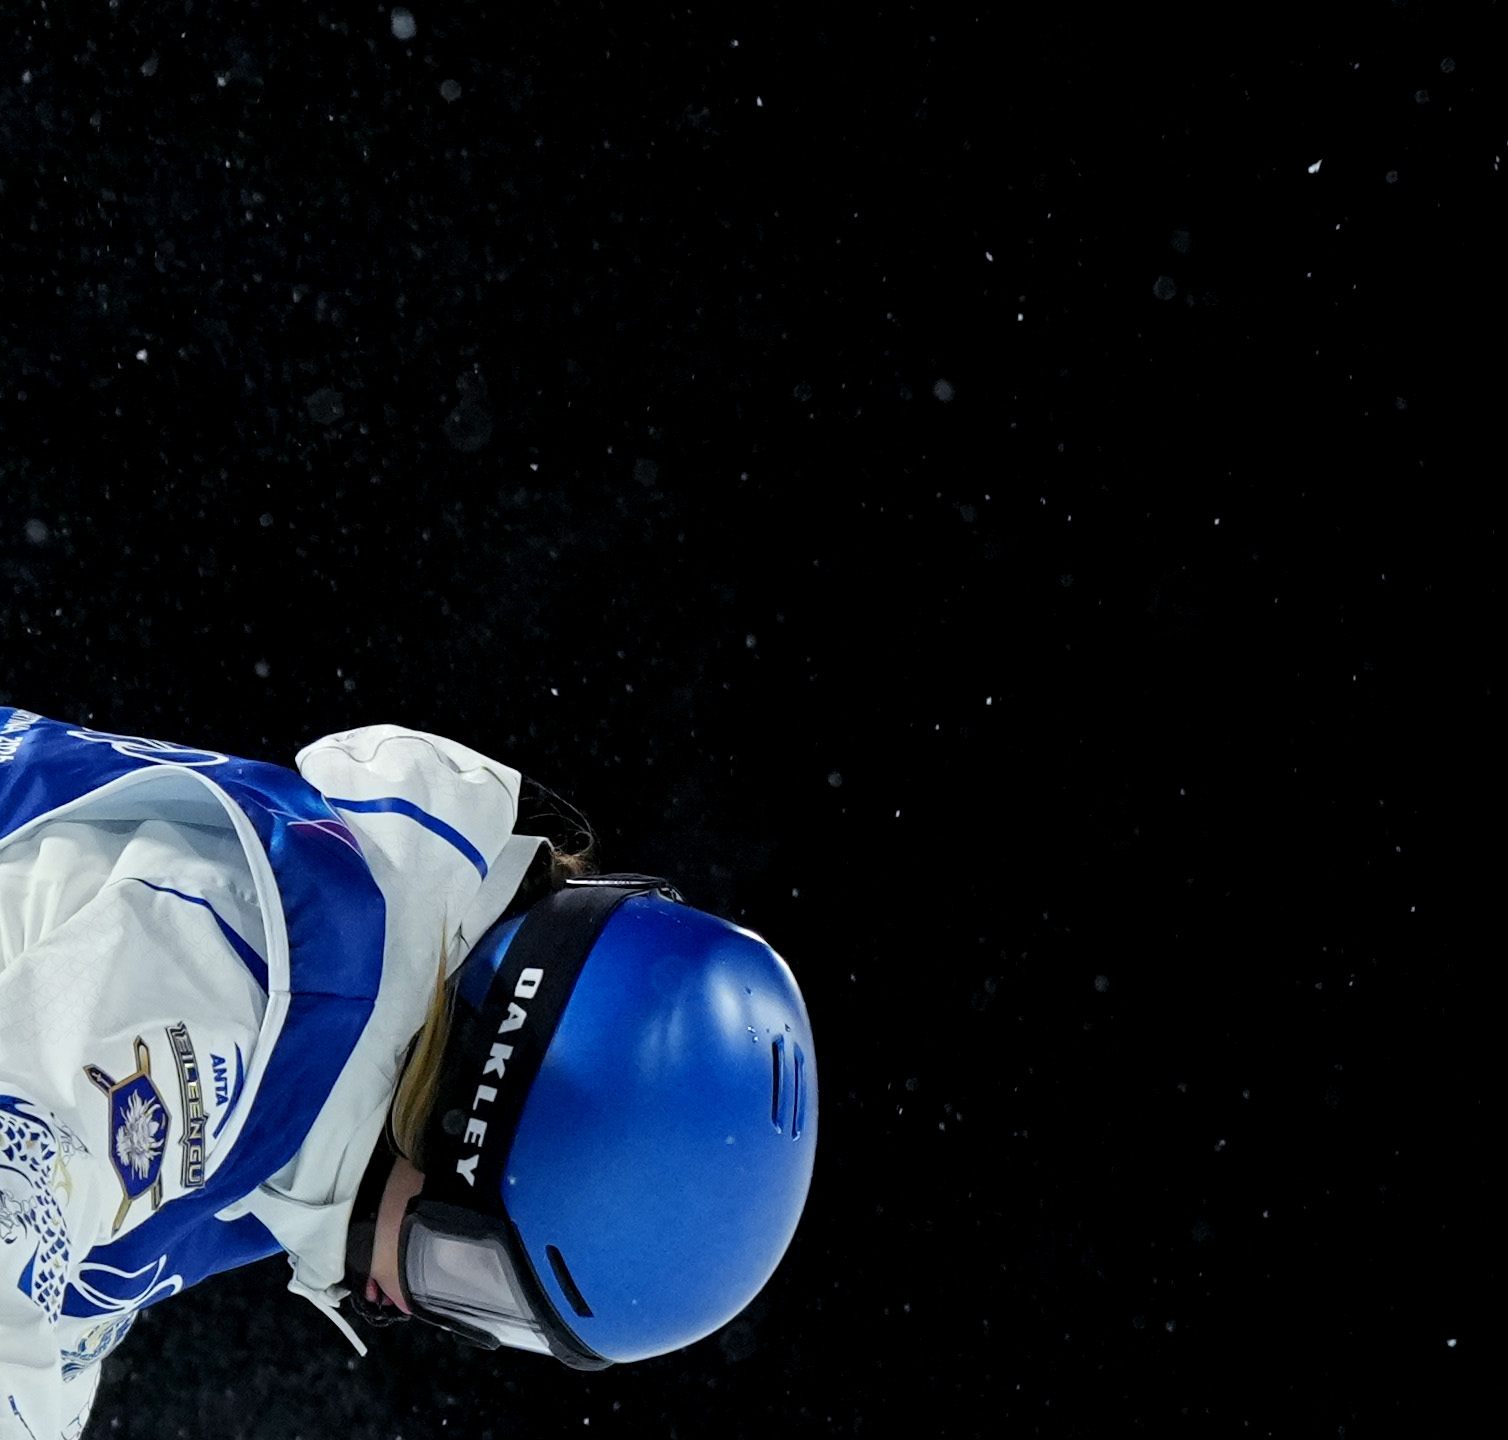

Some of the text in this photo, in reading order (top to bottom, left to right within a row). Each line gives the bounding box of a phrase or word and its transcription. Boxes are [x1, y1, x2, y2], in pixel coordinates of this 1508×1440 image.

[175, 1034, 203, 1183] EILEEN GU
[209, 1053, 229, 1107] ANTA
[456, 967, 544, 1187] OAKLEY
